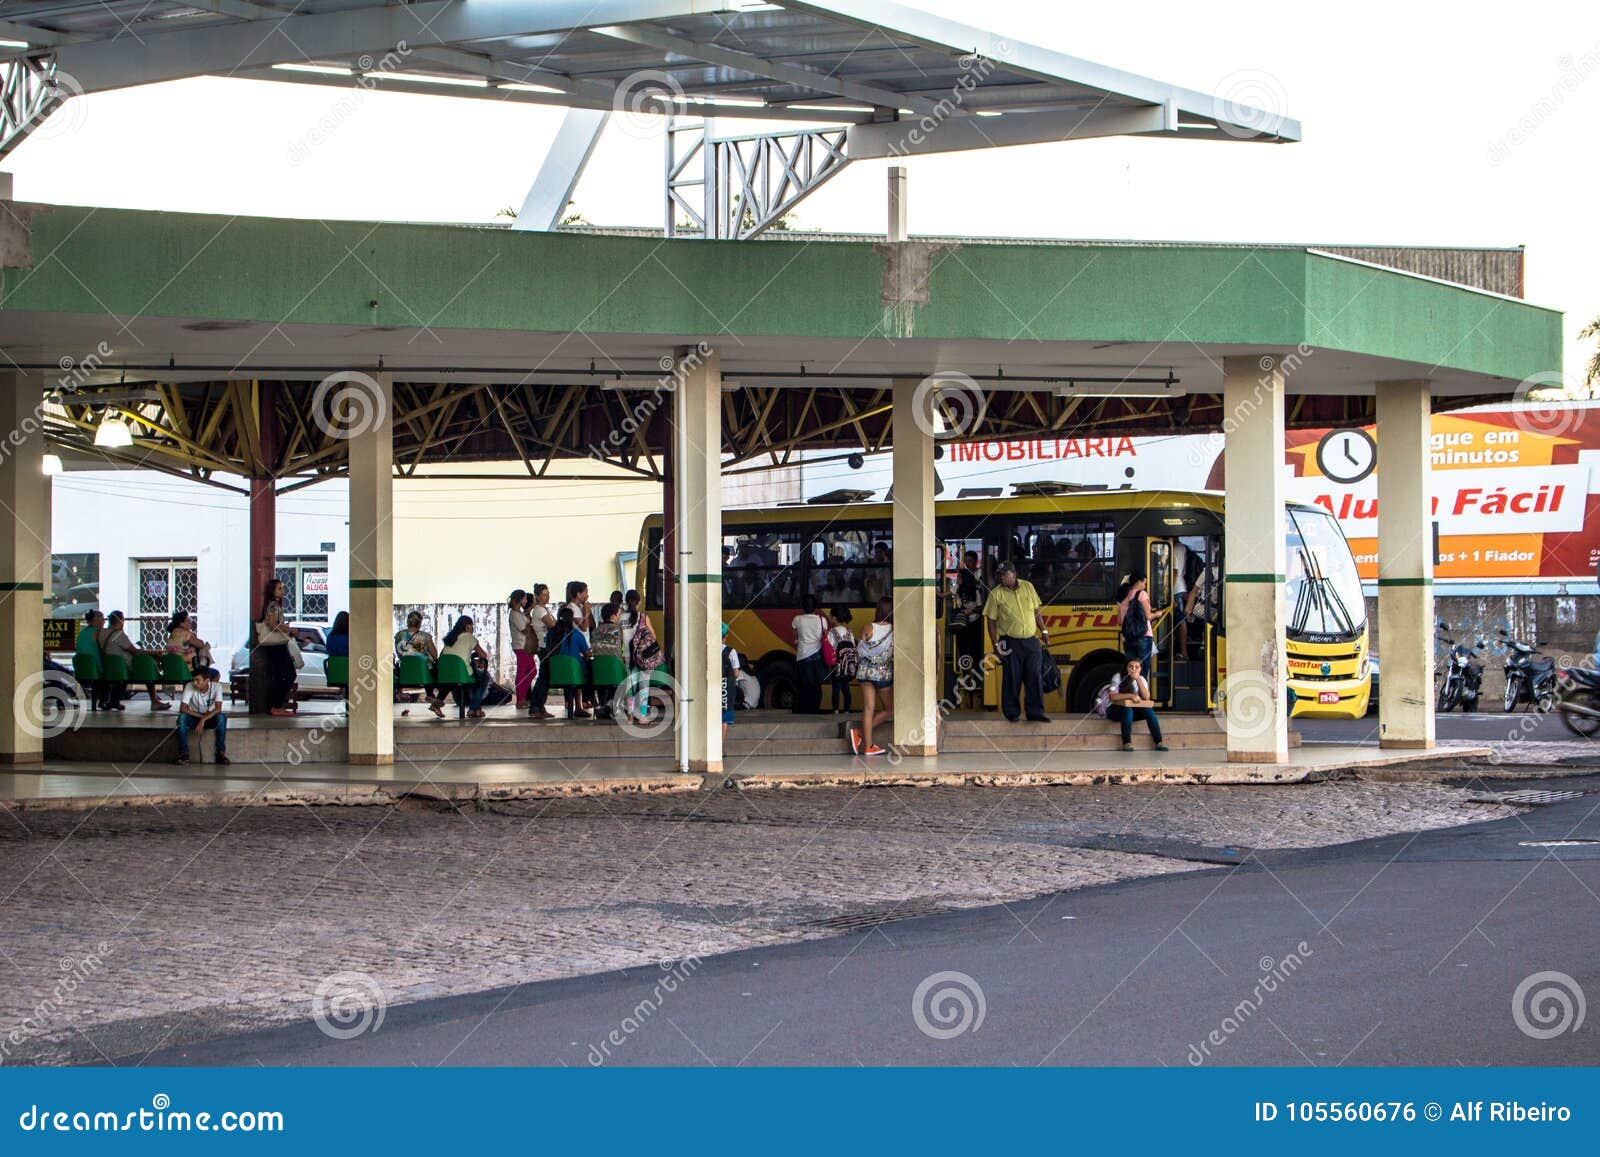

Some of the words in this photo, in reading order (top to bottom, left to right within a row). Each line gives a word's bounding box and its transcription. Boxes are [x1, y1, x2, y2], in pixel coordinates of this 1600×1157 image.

[1430, 432, 1473, 449] gue
[1484, 431, 1519, 444] em
[1431, 449, 1519, 464] minutos
[1313, 493, 1438, 519] Alu
[1452, 485, 1565, 515] Fácil
[1438, 552, 1455, 562] os
[1473, 550, 1480, 562] 1
[1485, 549, 1534, 562] Fiador
